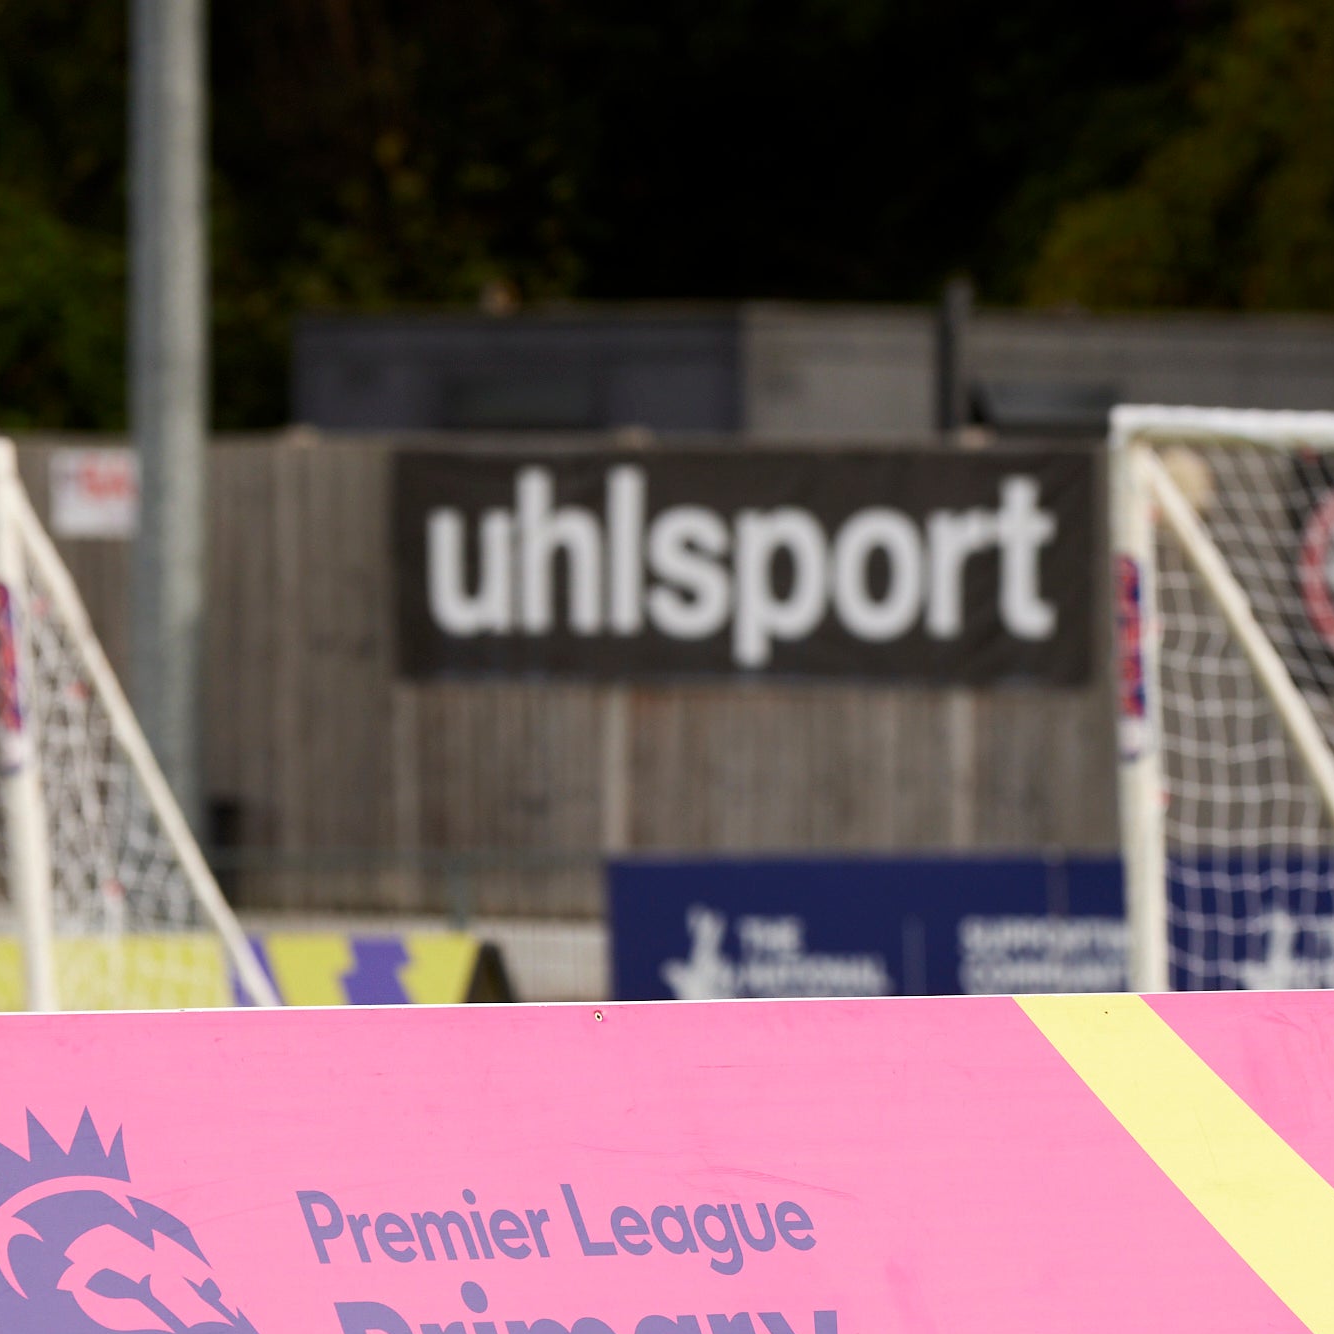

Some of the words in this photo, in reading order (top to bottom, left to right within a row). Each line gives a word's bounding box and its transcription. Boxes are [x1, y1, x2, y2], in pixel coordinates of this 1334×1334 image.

[426, 464, 1057, 667] uhlsport
[296, 1188, 551, 1264] Premier
[560, 1183, 817, 1275] League
